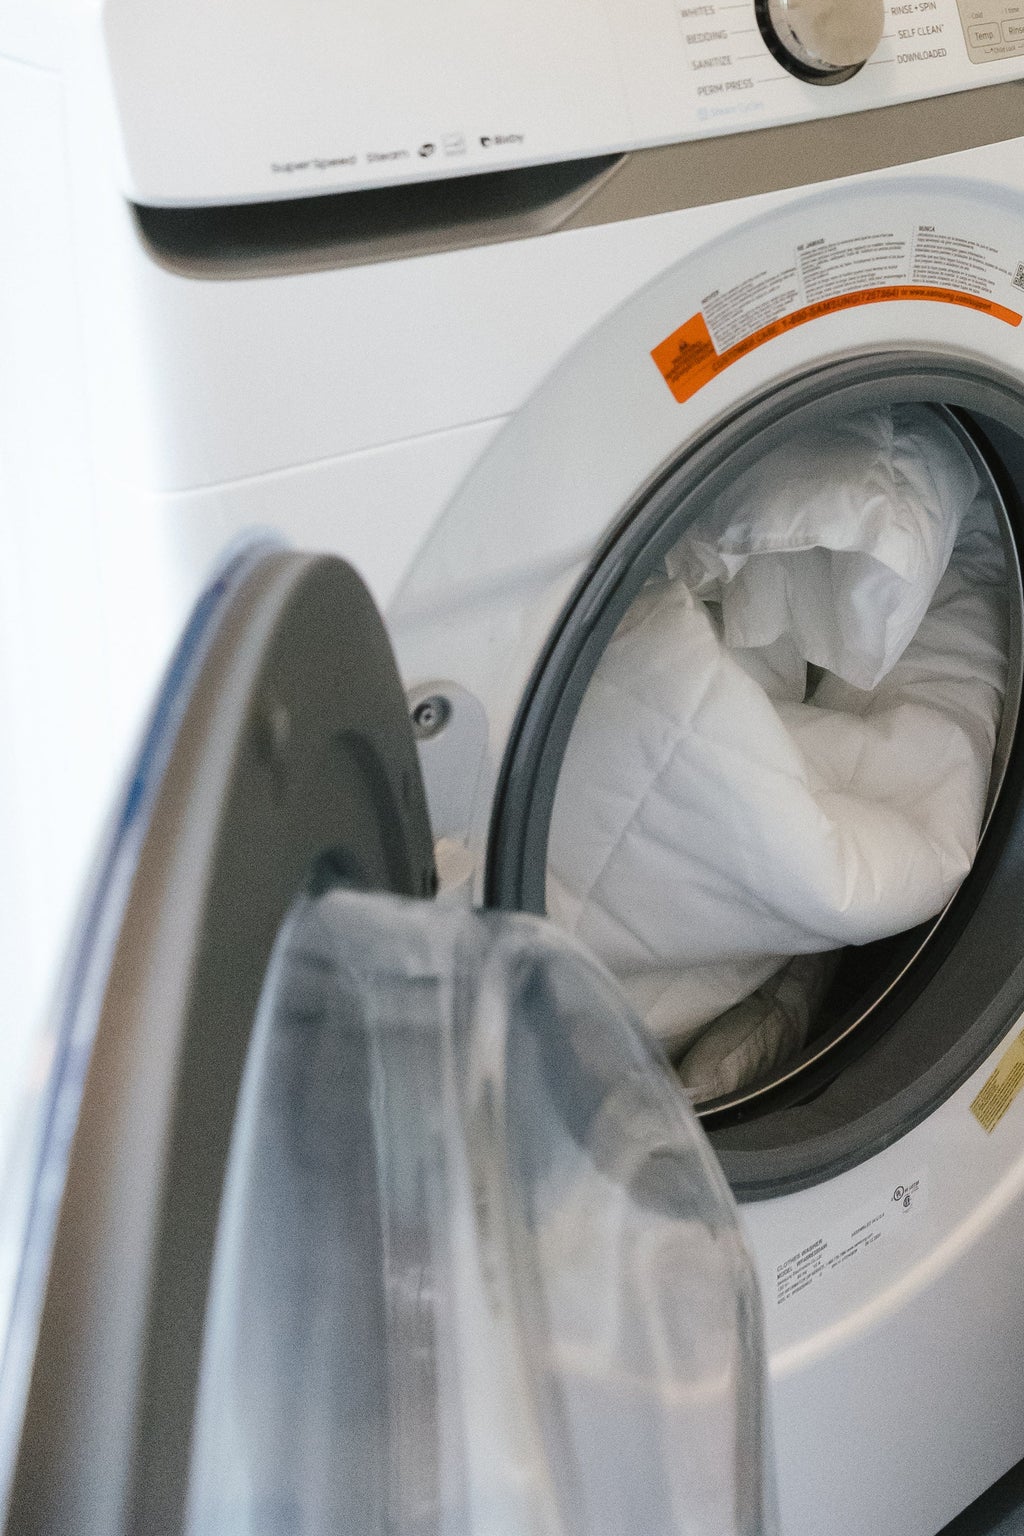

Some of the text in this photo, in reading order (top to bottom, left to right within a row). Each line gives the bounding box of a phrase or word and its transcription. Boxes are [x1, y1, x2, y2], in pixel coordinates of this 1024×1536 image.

[891, 5, 914, 16] RINSE
[919, 2, 937, 12] SPIN
[898, 28, 916, 40] SELF
[975, 31, 994, 41] Temp
[897, 48, 948, 64] DOWNLOADED
